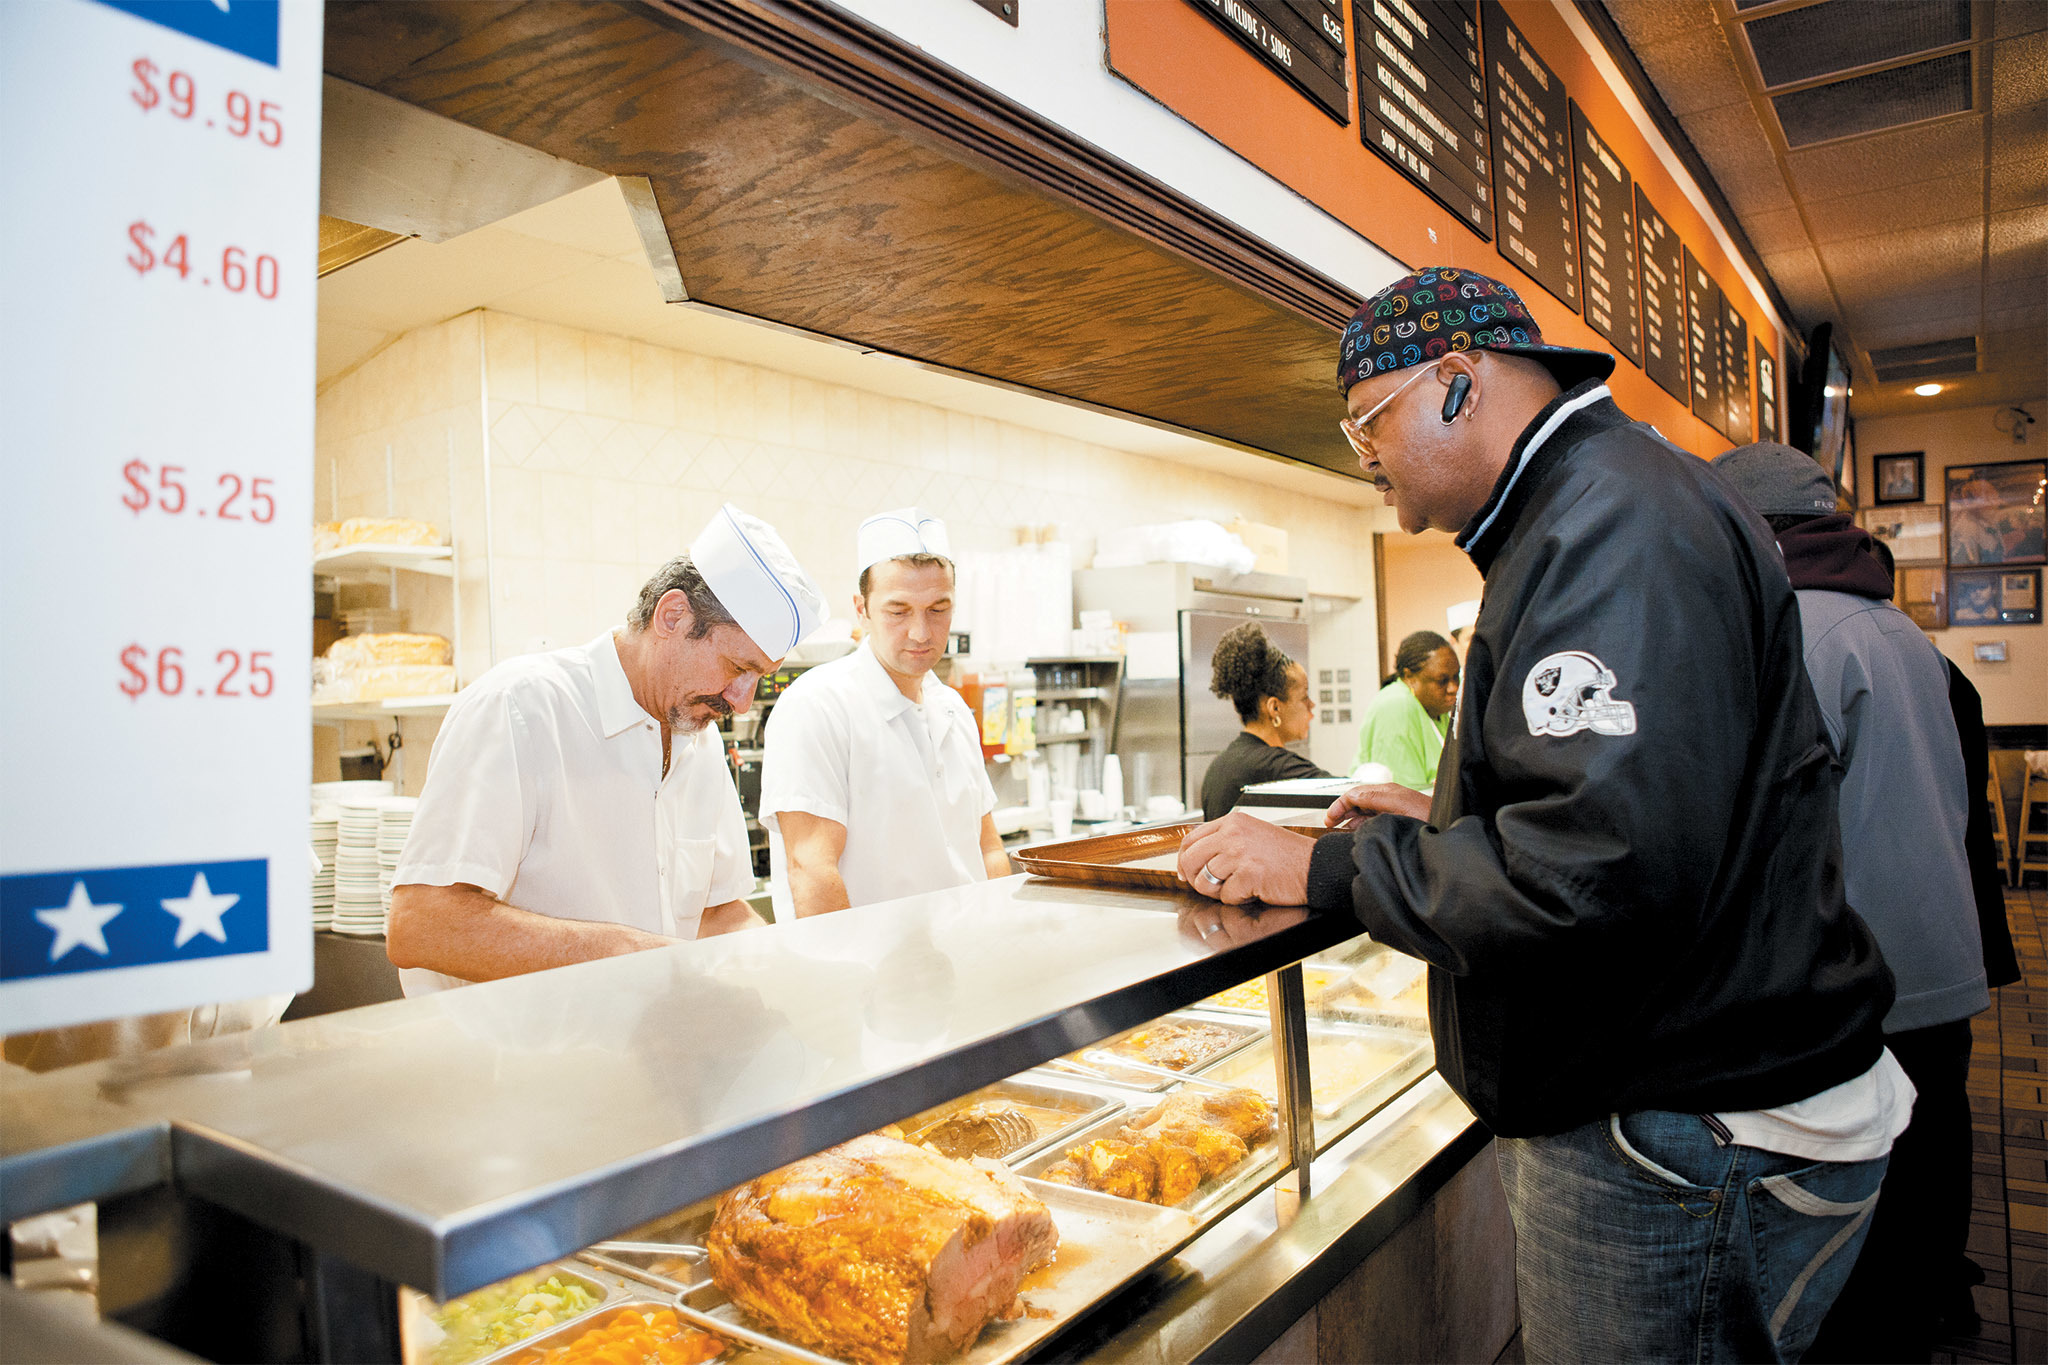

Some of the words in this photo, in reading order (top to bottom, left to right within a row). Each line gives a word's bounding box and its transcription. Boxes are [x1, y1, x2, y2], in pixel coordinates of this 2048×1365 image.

[1224, 0, 1258, 39] INCLUDE
[1261, 25, 1268, 47] 2
[1270, 34, 1292, 67] SIDES
[1322, 13, 1343, 44] 6.25
[130, 56, 283, 148] $9.95
[1377, 62, 1392, 90] MEAT
[1392, 75, 1405, 99] LOAF
[1379, 94, 1406, 131] MACARONI
[1406, 119, 1417, 141] AND
[1416, 128, 1435, 156] CHEESE
[1381, 128, 1397, 154] SOUP
[1398, 143, 1407, 162] OF
[1407, 150, 1419, 173] THE
[126, 219, 280, 300] $4.60
[121, 458, 276, 525] $5.25
[117, 644, 275, 700] $6.25
